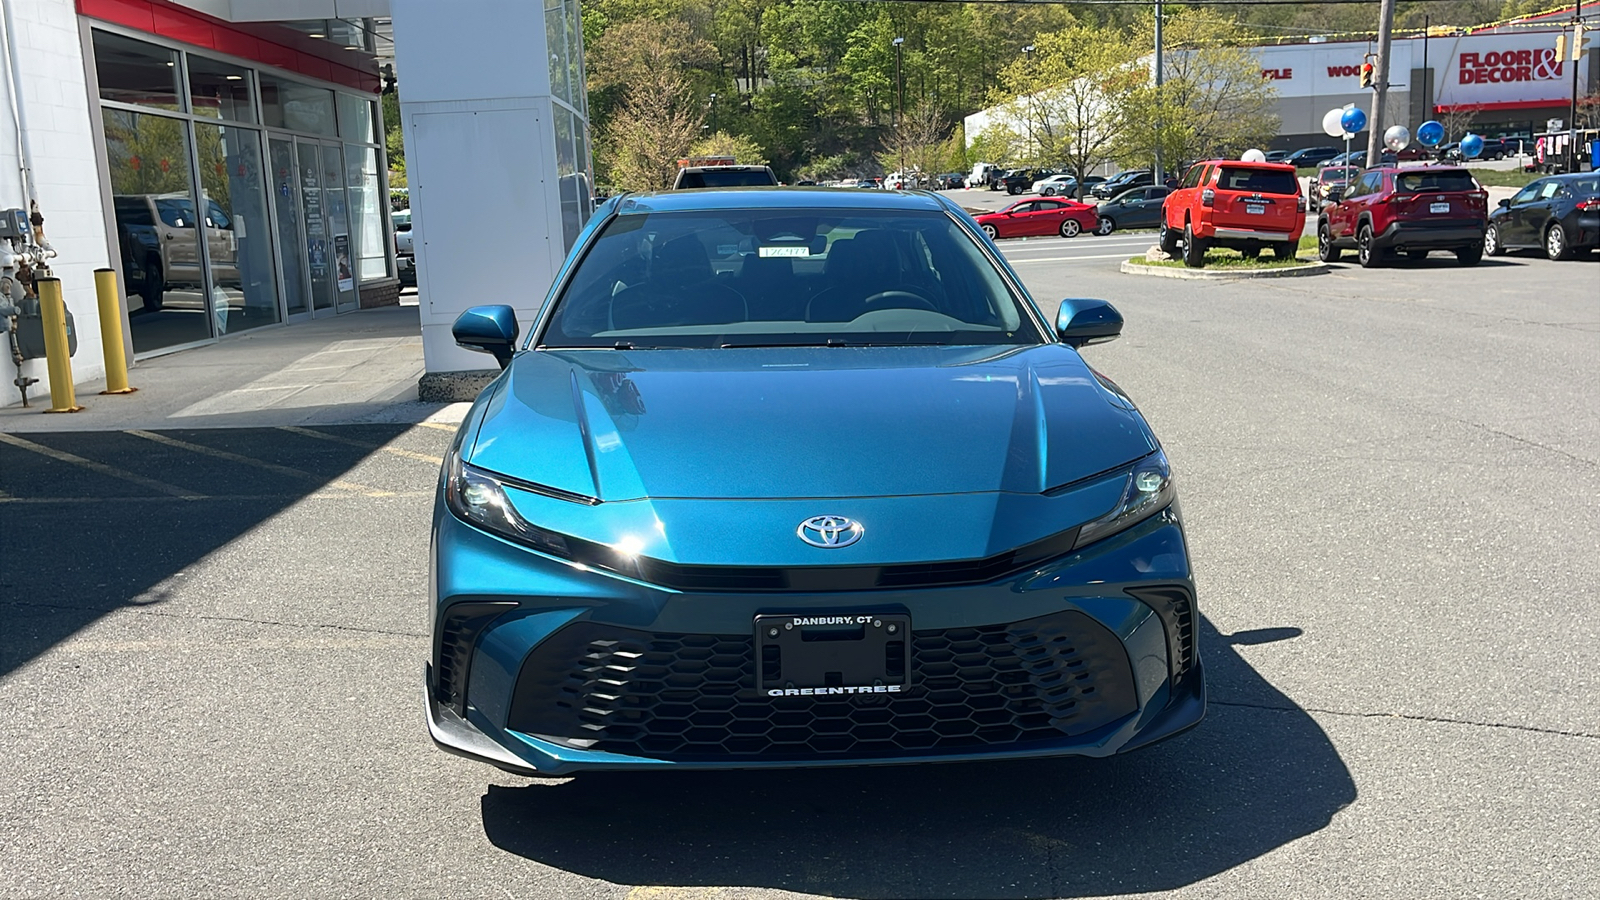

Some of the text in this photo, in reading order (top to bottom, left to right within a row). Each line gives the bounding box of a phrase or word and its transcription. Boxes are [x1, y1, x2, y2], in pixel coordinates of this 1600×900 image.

[1460, 48, 1563, 80] FLOOR &
[1327, 65, 1361, 77] WOO
[1459, 66, 1532, 84] DECOR
[793, 616, 873, 626] DANBURY, CT
[767, 685, 901, 697] GREENTREE
